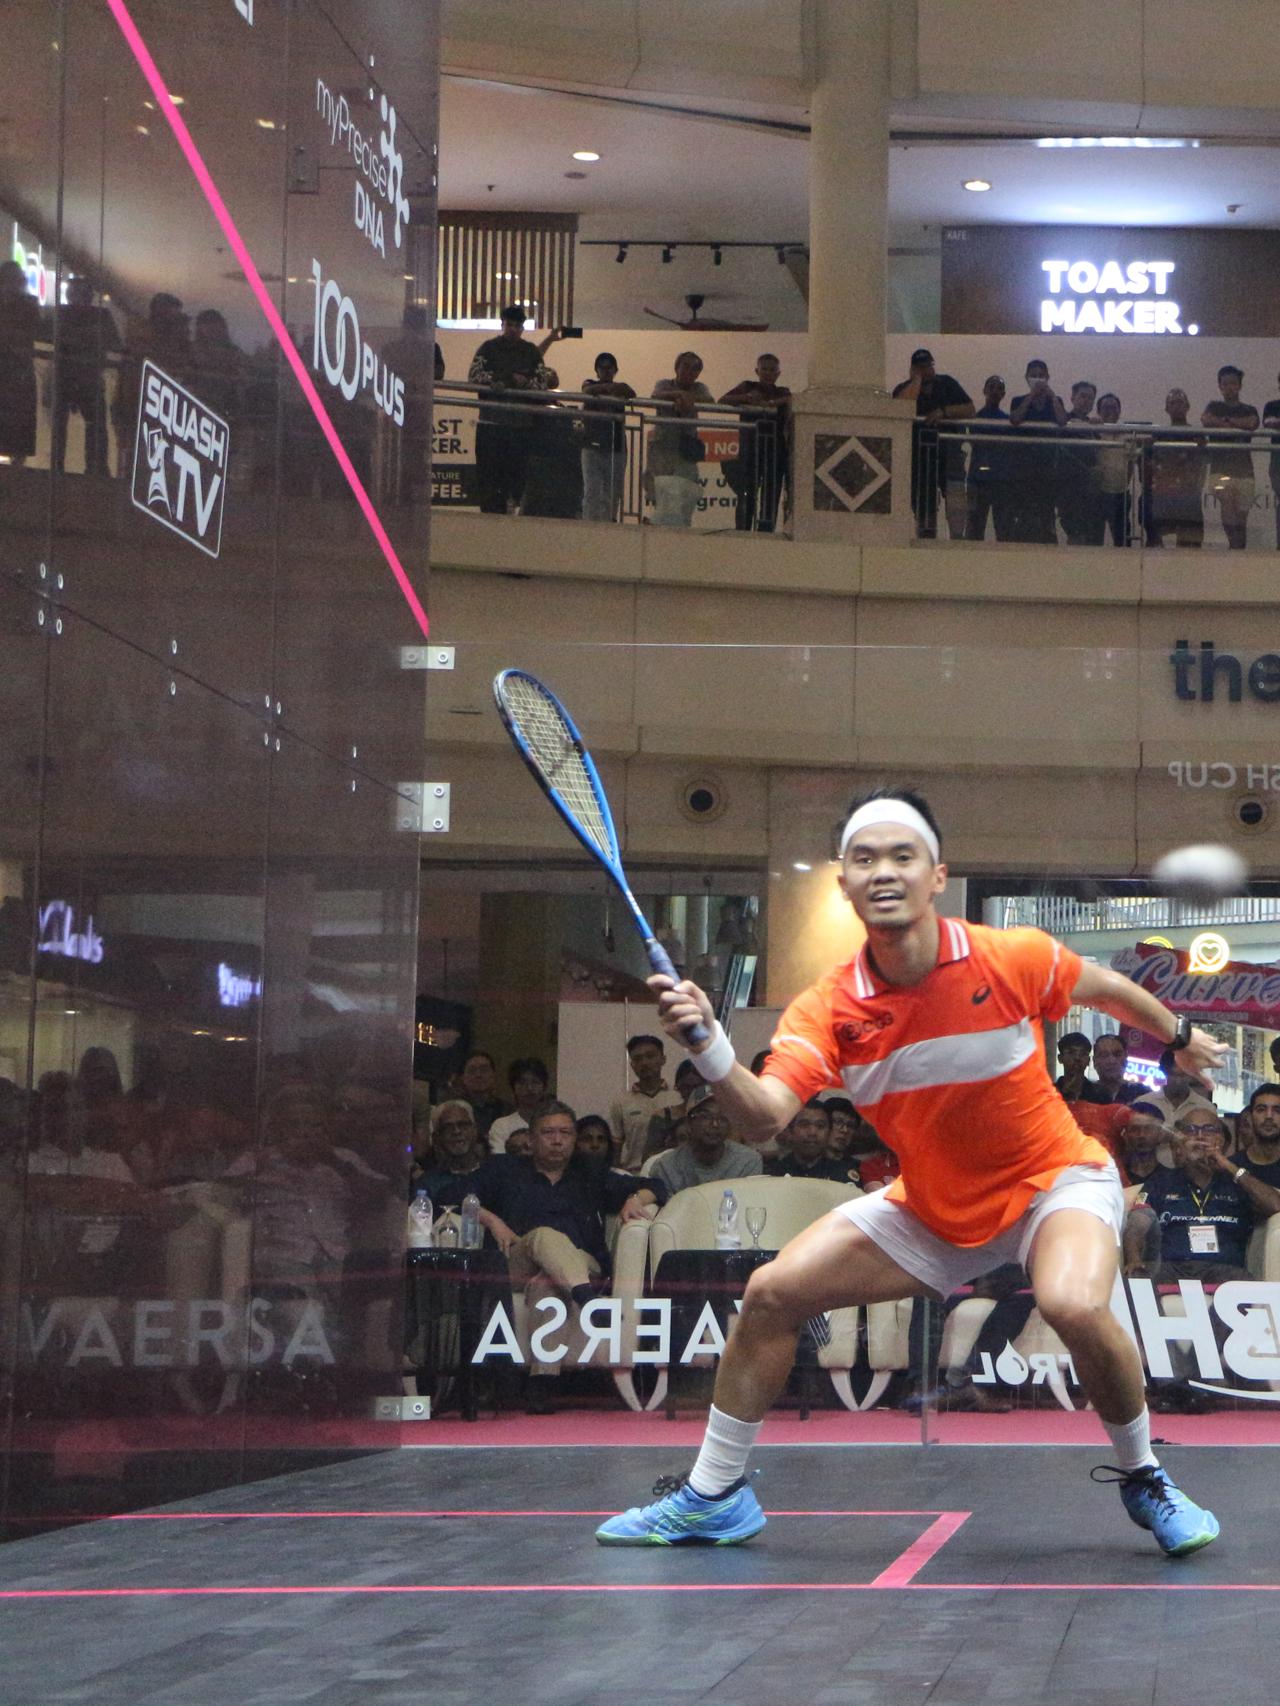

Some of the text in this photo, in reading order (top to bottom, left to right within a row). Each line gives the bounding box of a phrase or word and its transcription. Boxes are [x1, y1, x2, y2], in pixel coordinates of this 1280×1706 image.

[316, 78, 388, 198] myPrecise
[354, 180, 386, 259] DNA
[1040, 300, 1200, 336] MAKER.
[1041, 260, 1176, 294] TOAST
[145, 378, 225, 468] SQUASH
[173, 444, 222, 537] TV
